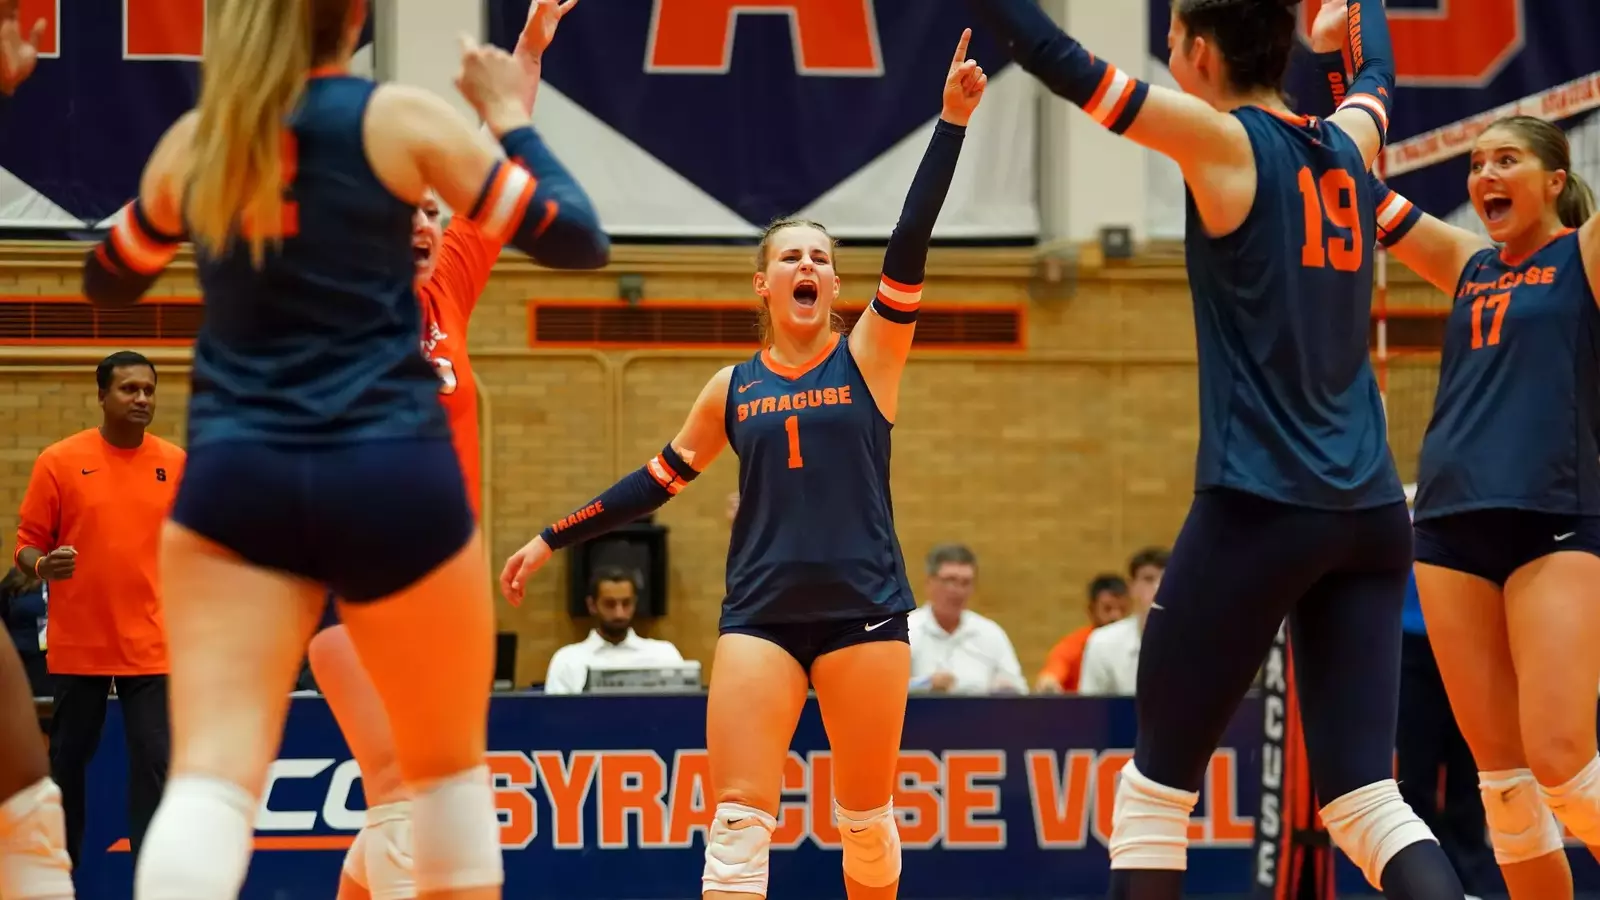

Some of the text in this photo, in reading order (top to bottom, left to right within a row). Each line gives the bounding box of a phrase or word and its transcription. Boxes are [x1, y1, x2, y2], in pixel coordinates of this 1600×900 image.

[1349, 2, 1363, 71] ORANGE
[1298, 166, 1363, 272] 19
[1471, 291, 1511, 350] 17
[737, 385, 852, 422] SYRACUSE
[785, 415, 803, 469] 1
